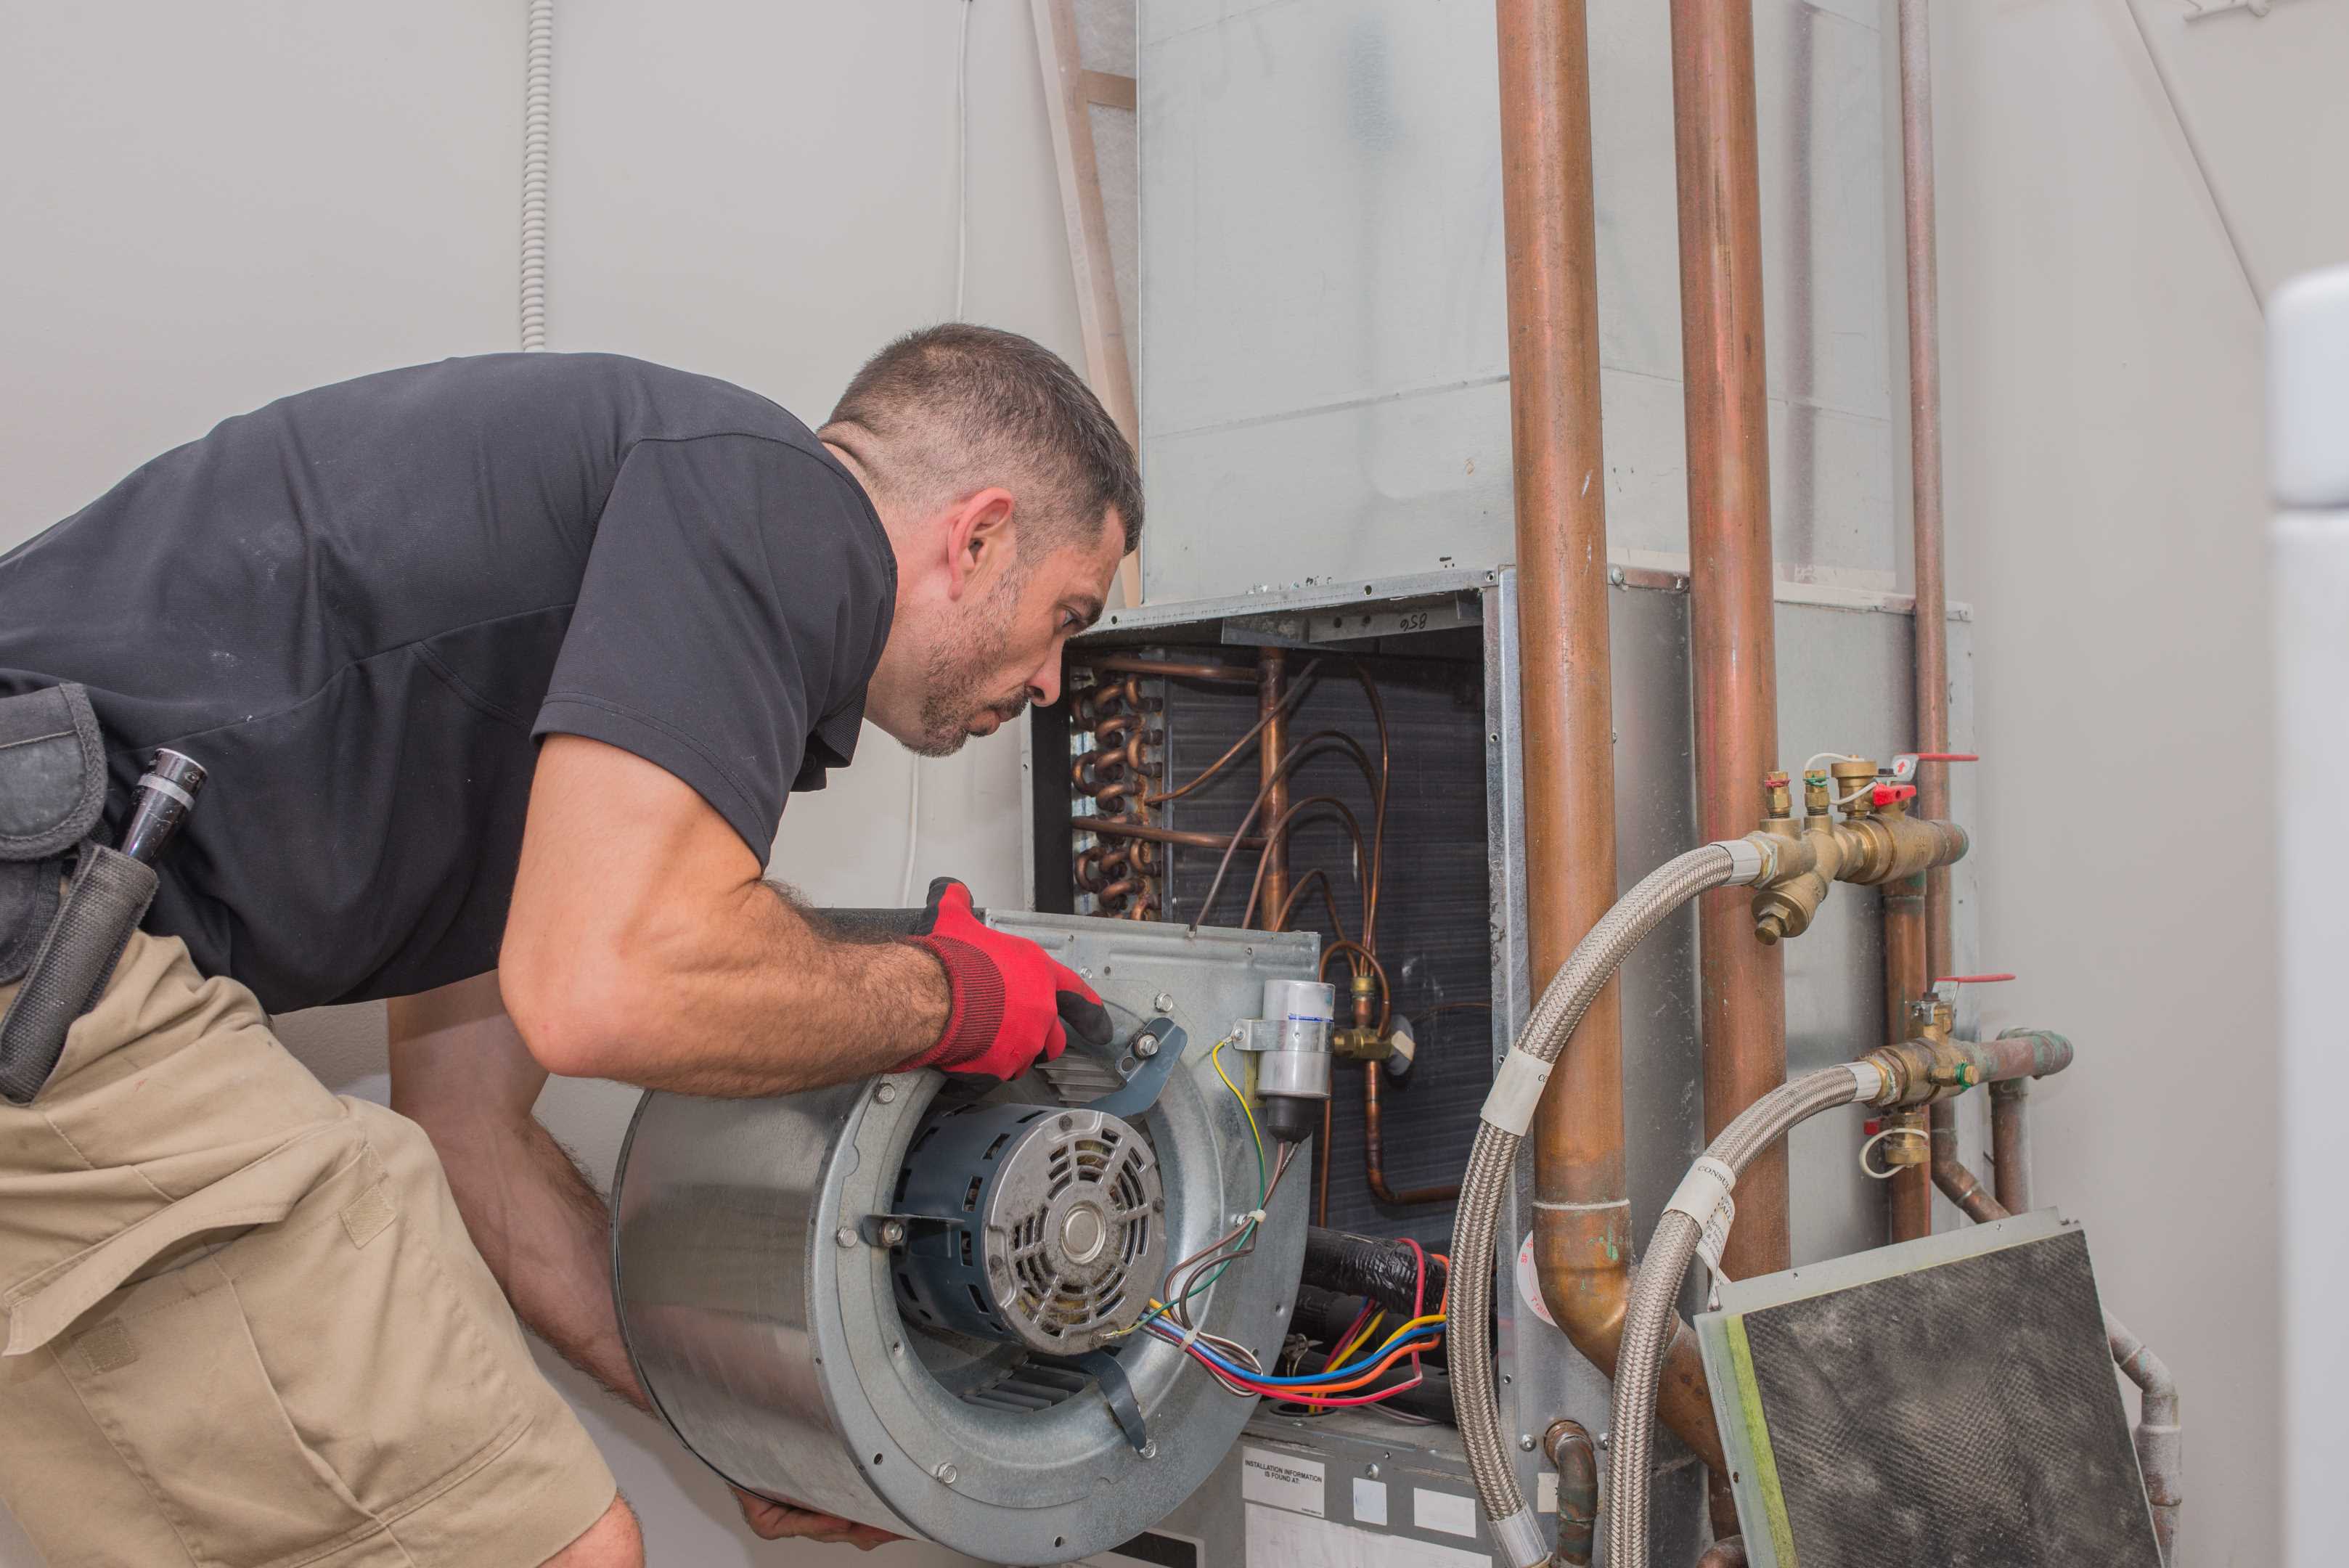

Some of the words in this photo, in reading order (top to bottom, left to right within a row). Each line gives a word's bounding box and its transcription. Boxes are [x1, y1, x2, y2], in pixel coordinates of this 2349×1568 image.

[1244, 1460, 1283, 1474] INSTALLATION
[1283, 1468, 1323, 1482] INFORMATION
[1271, 1472, 1291, 1482] FOUND
